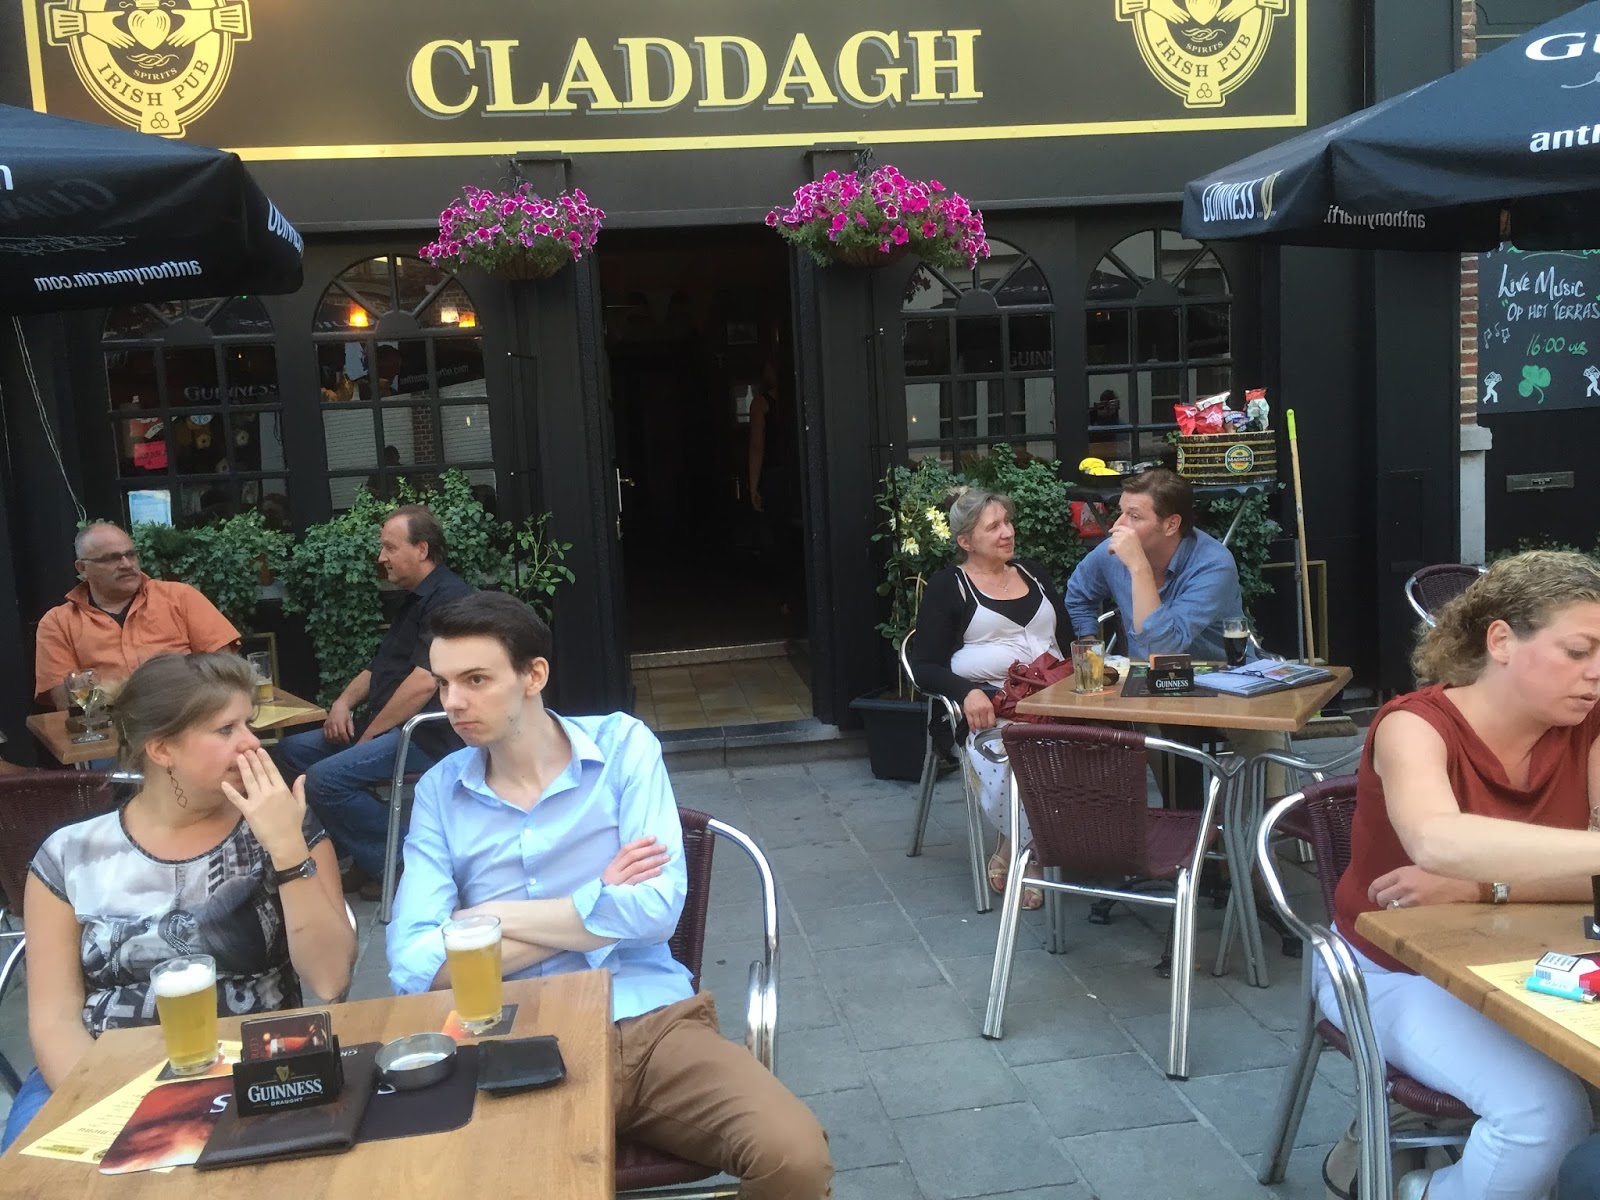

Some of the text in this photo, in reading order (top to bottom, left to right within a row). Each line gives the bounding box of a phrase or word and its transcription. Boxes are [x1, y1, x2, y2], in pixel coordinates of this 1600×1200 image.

[1156, 34, 1251, 77] IRISH PUB
[1186, 41, 1224, 53] SPIRITS
[98, 59, 209, 106] IRISH PUB
[132, 68, 178, 80] SPIRITS
[408, 29, 984, 116] CLADDAGH
[1202, 178, 1263, 222] GUINNESS
[1528, 303, 1550, 321] HET
[1526, 334, 1566, 356] 16:00
[1155, 679, 1189, 689] GUINNESS
[247, 1078, 323, 1103] GUINNESS
[270, 1097, 304, 1107] DRAUGHT
